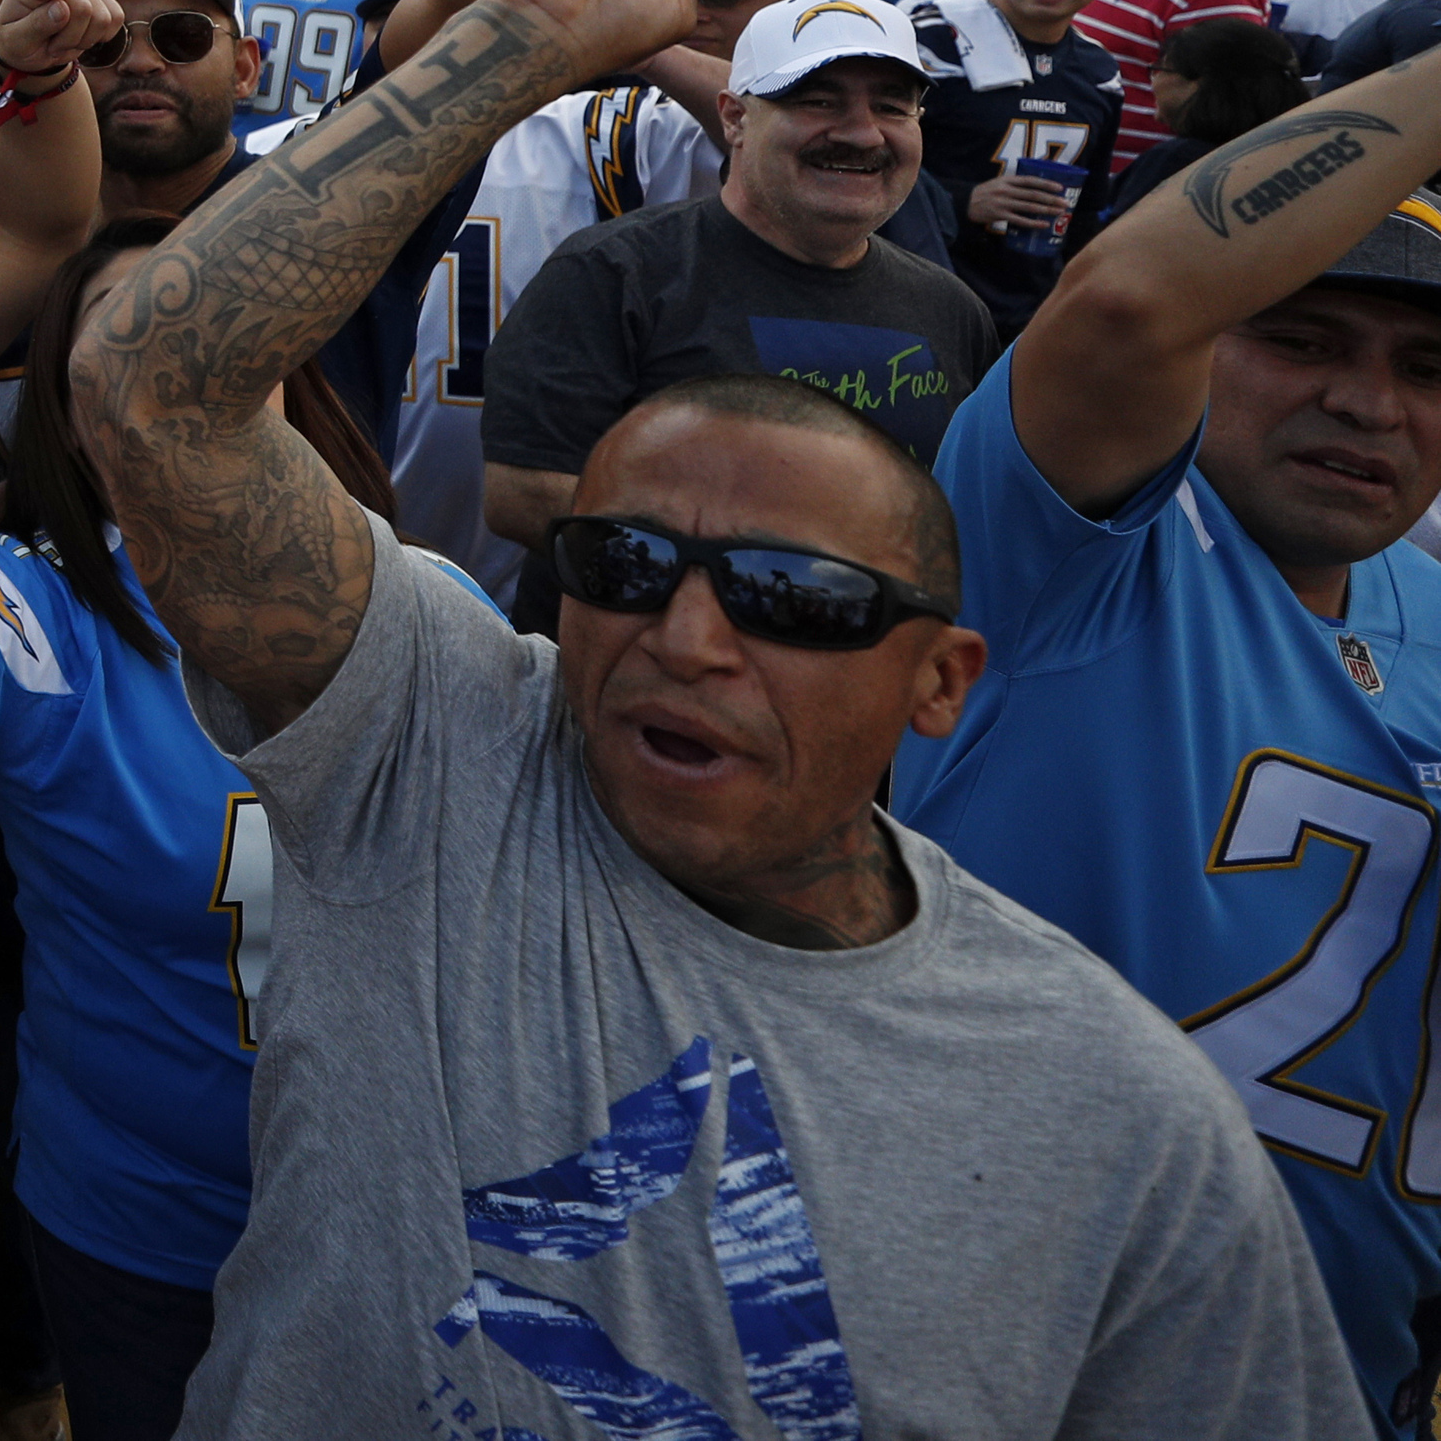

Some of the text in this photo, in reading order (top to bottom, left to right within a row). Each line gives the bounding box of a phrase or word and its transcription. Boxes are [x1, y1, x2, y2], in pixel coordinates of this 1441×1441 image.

[1020, 98, 1067, 115] CHARGERS
[1231, 130, 1367, 228] CHARGERS
[1348, 658, 1378, 692] NFL
